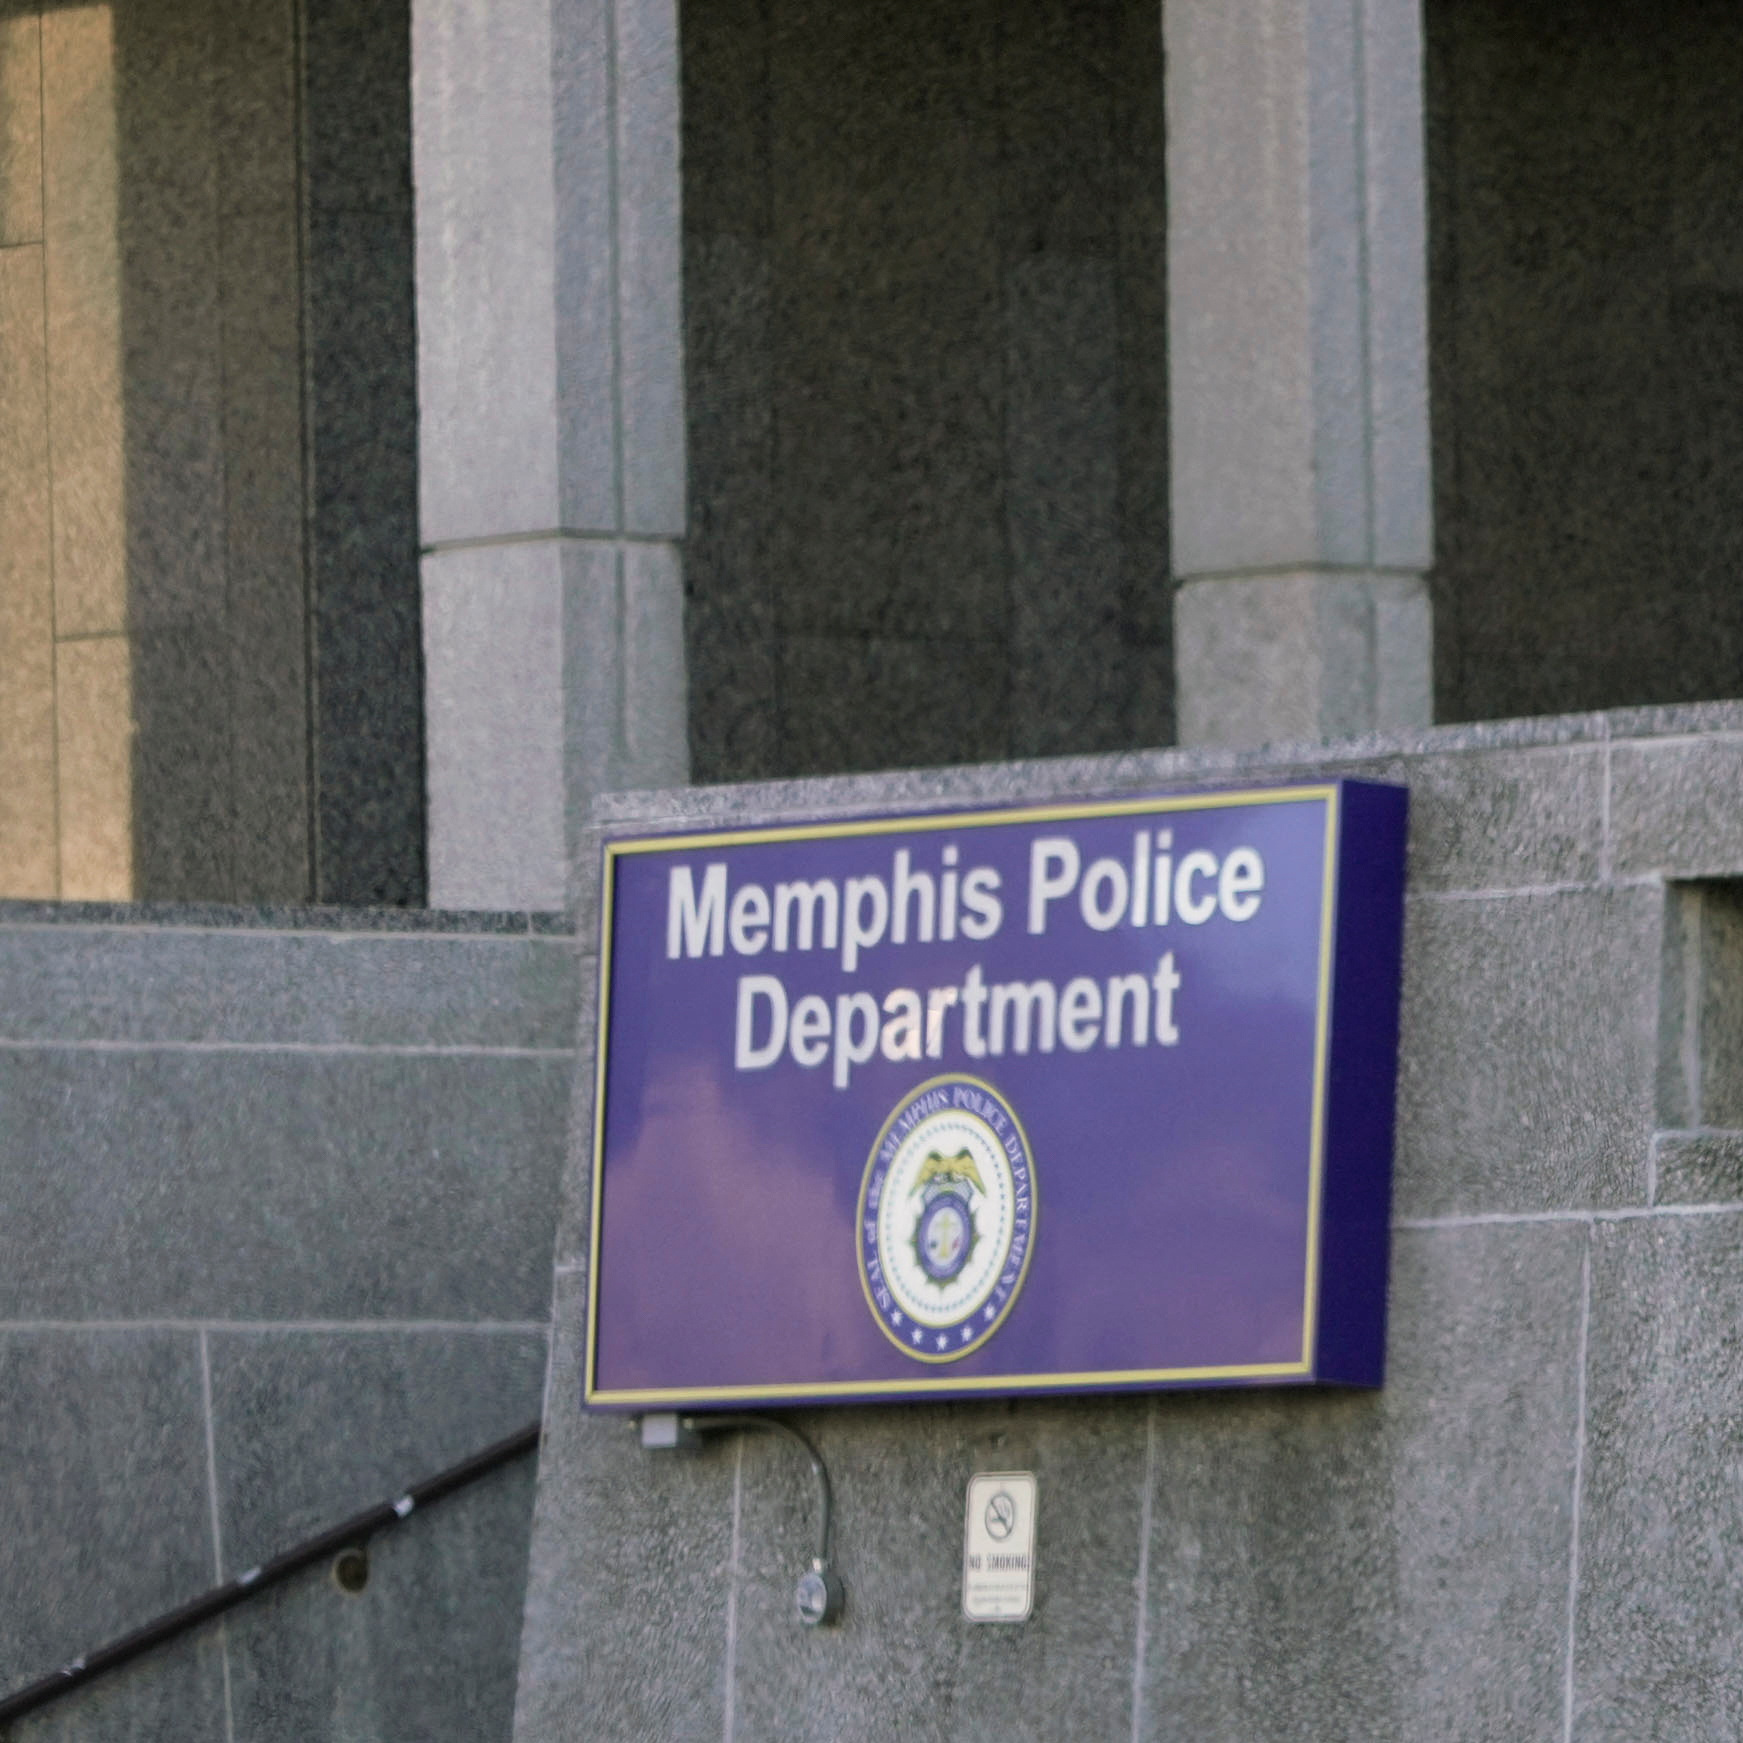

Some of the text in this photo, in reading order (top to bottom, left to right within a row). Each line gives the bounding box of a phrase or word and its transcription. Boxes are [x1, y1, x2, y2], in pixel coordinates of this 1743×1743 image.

[665, 828, 1266, 972] Memphis Police
[734, 951, 1181, 1090] Department
[867, 1256, 891, 1310] SEAL
[879, 1087, 949, 1161] MEMPHIS
[953, 1087, 1007, 1133] POLICE
[994, 1135, 1029, 1300] DEPARTMENT
[968, 1553, 982, 1571] NO
